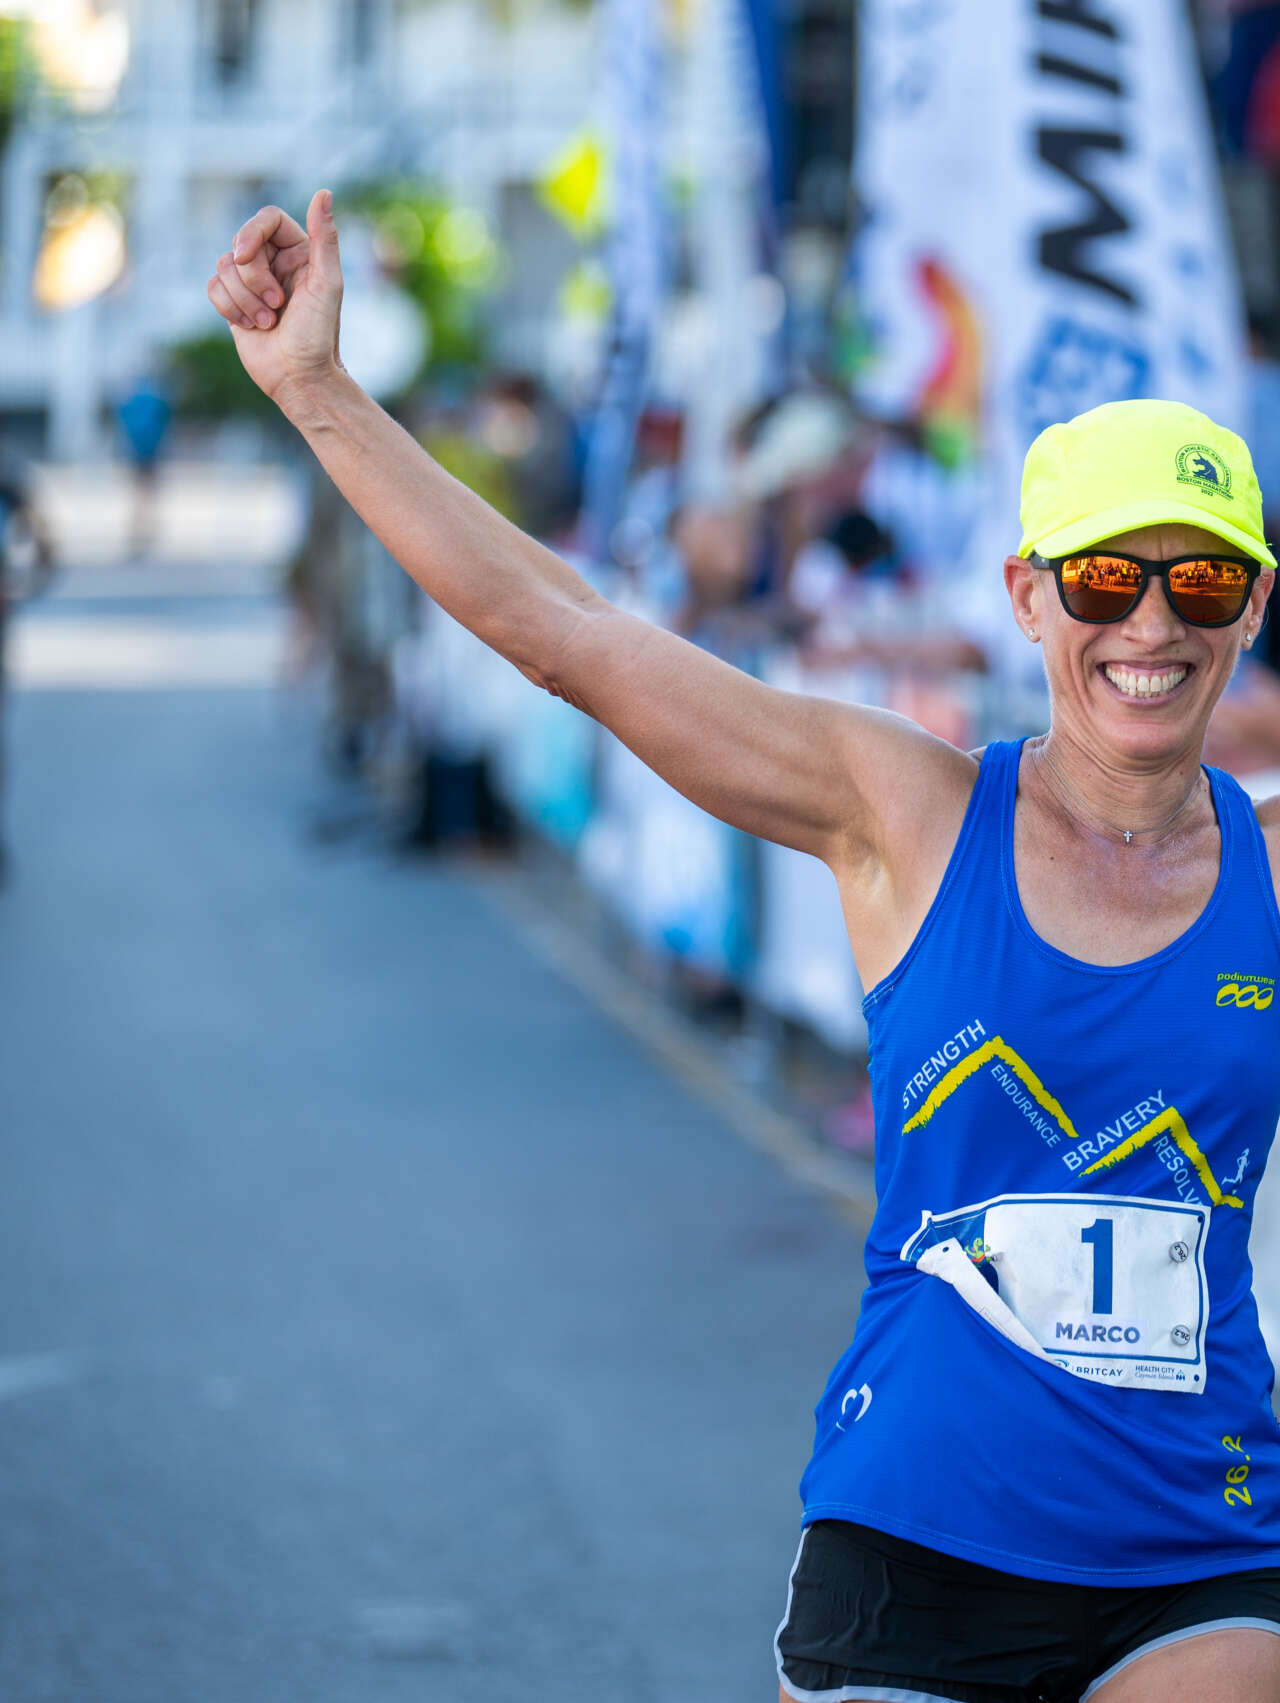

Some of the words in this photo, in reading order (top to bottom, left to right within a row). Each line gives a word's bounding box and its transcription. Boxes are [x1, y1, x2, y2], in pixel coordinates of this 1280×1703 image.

[1034, 0, 1143, 308] MI
[901, 1019, 986, 1110] STRENGTH
[990, 1064, 1060, 1149] ENDURANCE
[1062, 1089, 1167, 1171] BRAVERY
[1153, 1136, 1202, 1206] RESOLV
[1081, 1218, 1113, 1315] 1
[1055, 1321, 1140, 1344] MARCO
[1135, 1364, 1160, 1373] HEALTH
[1161, 1366, 1175, 1374] CITY
[1076, 1366, 1123, 1377] BRITCAY
[1222, 1435, 1252, 1506] 26.2
